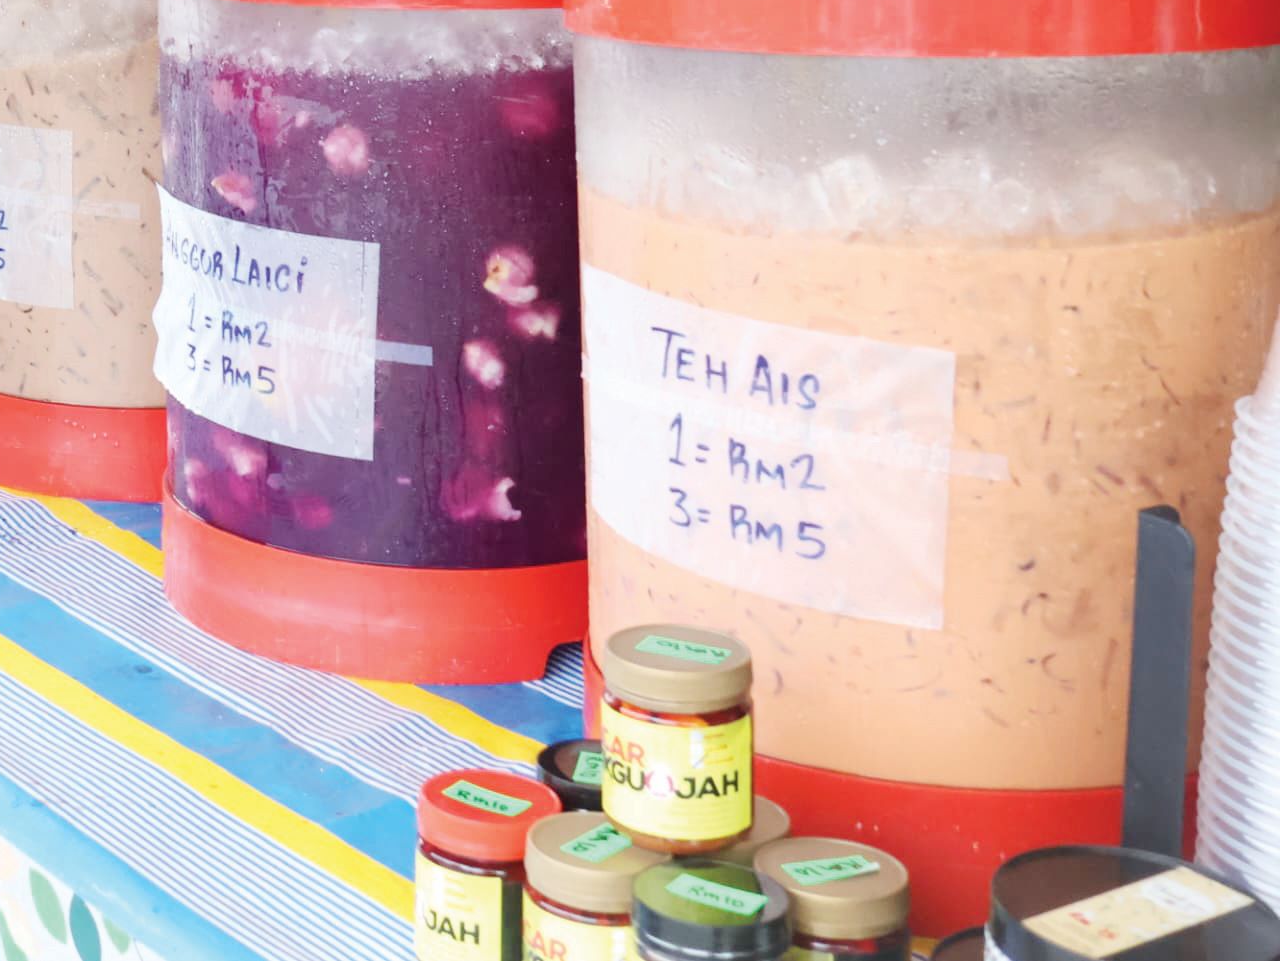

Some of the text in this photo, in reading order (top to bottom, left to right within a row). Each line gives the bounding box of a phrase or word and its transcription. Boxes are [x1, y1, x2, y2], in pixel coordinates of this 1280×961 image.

[650, 325, 822, 411] TEH AIS
[675, 769, 740, 800] JAH
[424, 908, 480, 945] JAH
